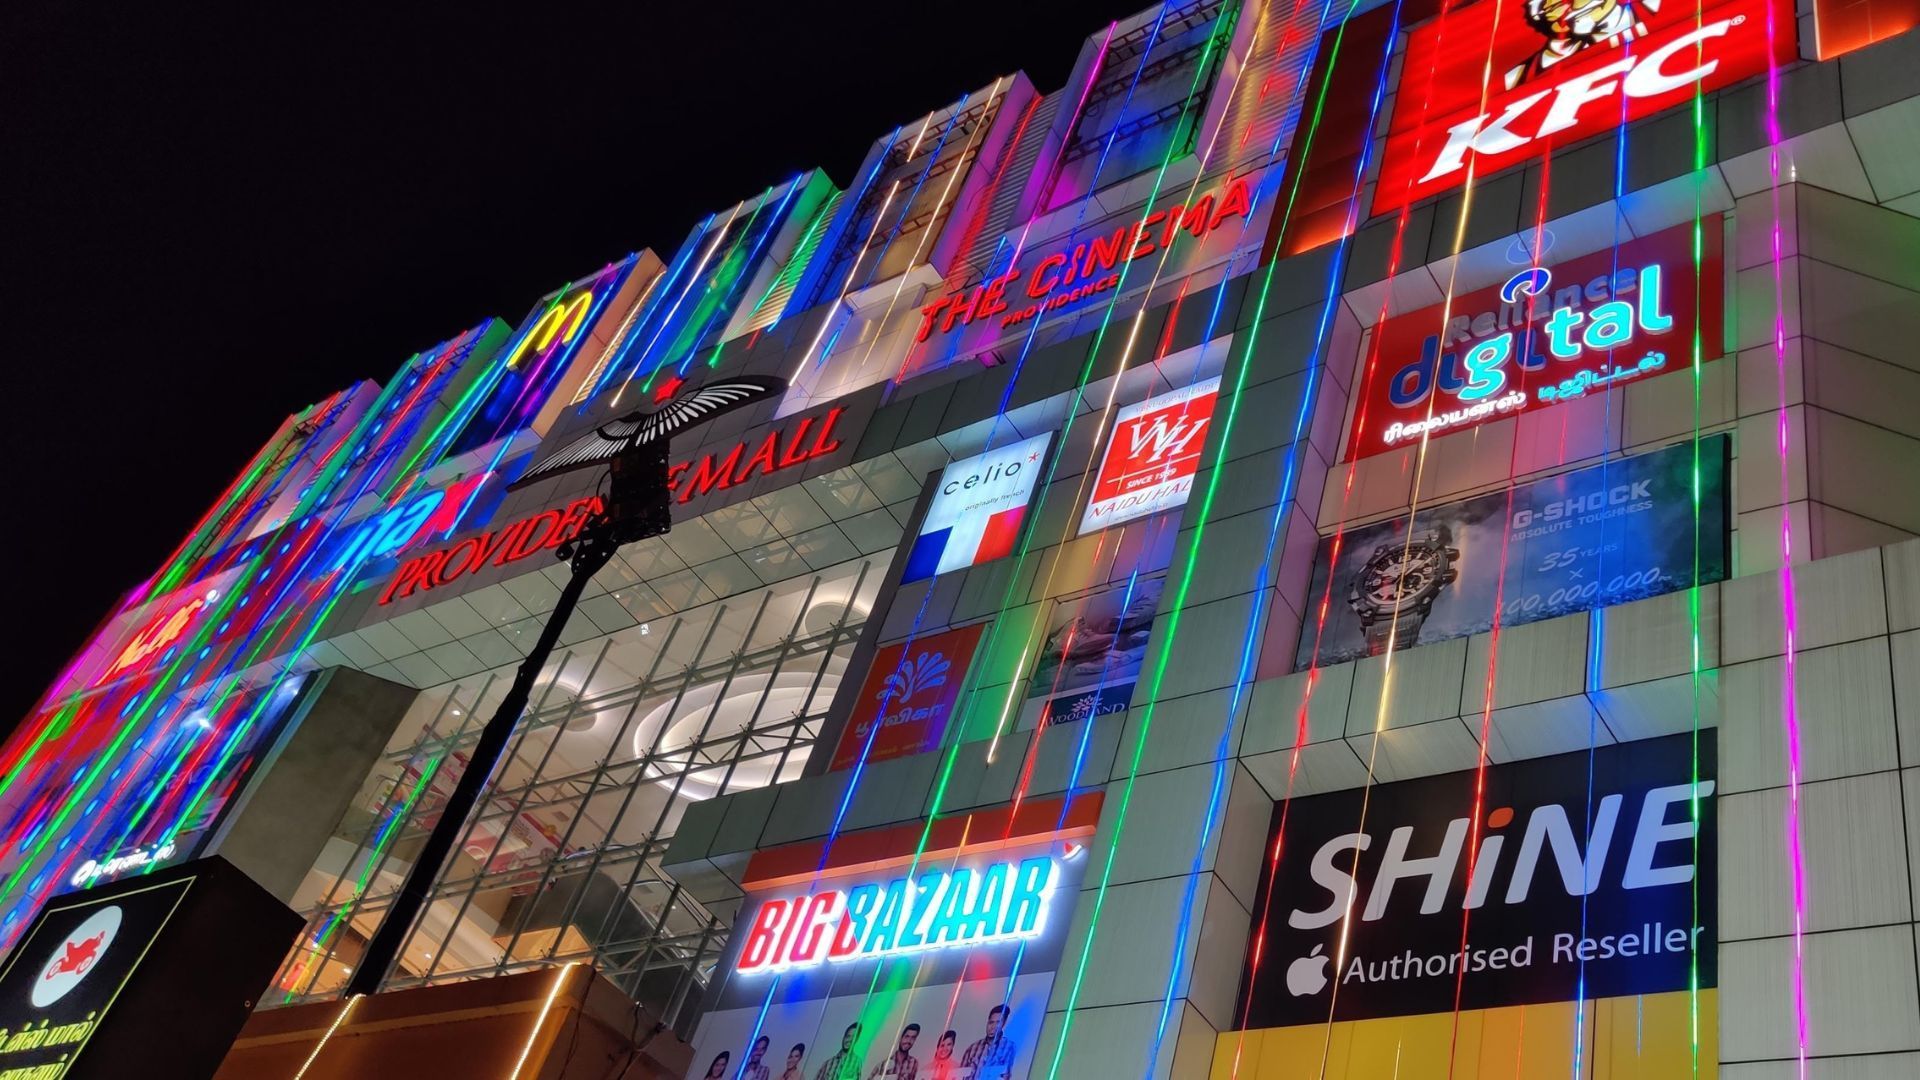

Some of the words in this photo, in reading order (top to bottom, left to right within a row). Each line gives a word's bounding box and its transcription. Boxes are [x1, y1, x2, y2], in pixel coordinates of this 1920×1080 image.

[1418, 18, 1731, 184] KFC
[917, 270, 1020, 343] THE
[1027, 179, 1252, 299] CINEMA
[1001, 272, 1120, 329] PROVIDENCE
[1443, 266, 1639, 348] Reliance
[1387, 264, 1673, 408] digital
[1383, 390, 1528, 443] ரிலையன்ஸ்
[943, 461, 1022, 496] celio
[1089, 491, 1151, 519] NAIDU
[1126, 475, 1154, 489] SINCE
[1512, 478, 1652, 530] G-SHOCK
[378, 460, 693, 606] PROVIDEN
[1510, 520, 1573, 542] ABSOLUTE
[1577, 500, 1653, 526] TOUGHNESS
[1538, 546, 1581, 572] 35
[1579, 543, 1619, 557] YEARS
[736, 890, 842, 975] BIG
[828, 856, 1060, 962] BAZAAR
[1342, 934, 1534, 986] Authorised
[1552, 921, 1705, 965] Reseller
